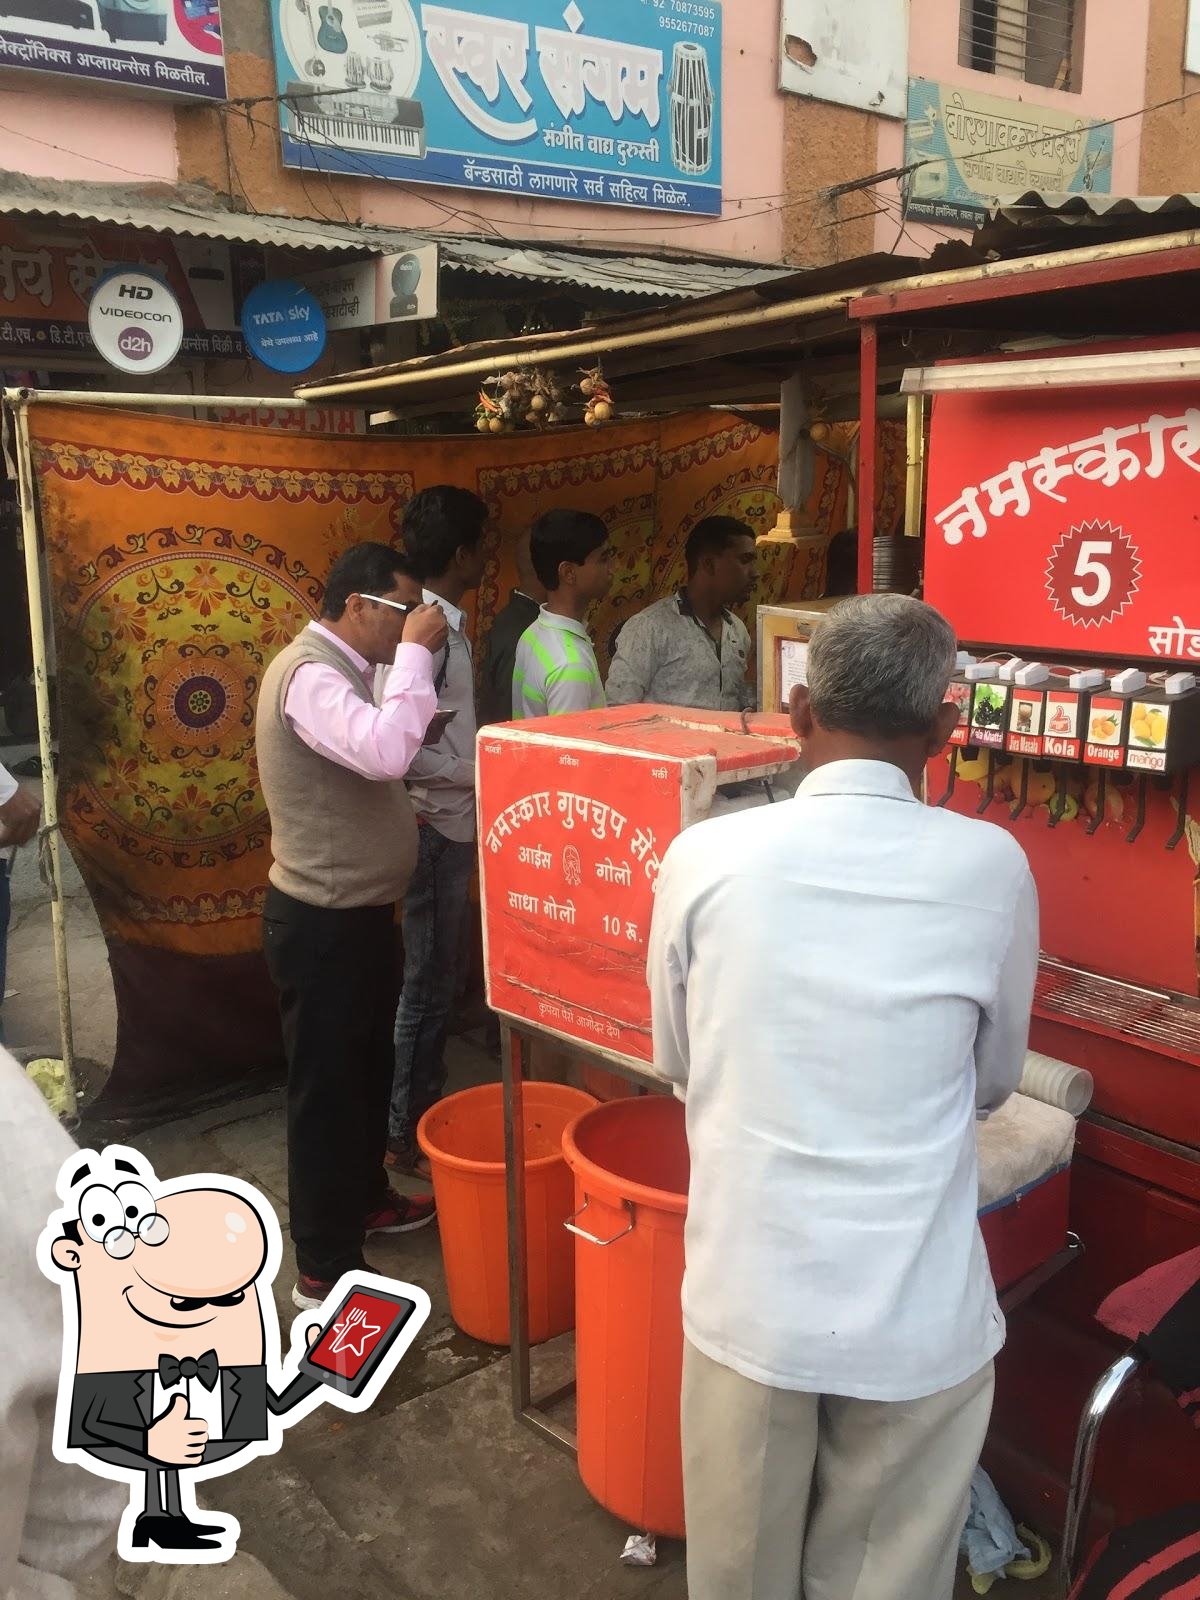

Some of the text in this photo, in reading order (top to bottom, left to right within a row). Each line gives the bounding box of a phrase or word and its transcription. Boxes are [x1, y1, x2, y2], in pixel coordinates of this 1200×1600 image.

[670, 0, 715, 20] 70873595
[658, 16, 715, 37] 9552677087
[77, 53, 151, 77] अप्लायन्सेस
[154, 61, 210, 86] मिळतील.
[543, 123, 584, 151] संगीत
[588, 133, 614, 156] वाद्य
[463, 158, 523, 188] बॅन्डसाठी
[529, 172, 578, 194] लागणारे
[584, 178, 604, 197] सर्व
[652, 185, 692, 208] मिळेल.
[118, 283, 154, 301] HD
[253, 311, 284, 325] TATA
[119, 335, 152, 353] d2h
[303, 330, 319, 342] आहे
[1071, 540, 1112, 607] 5
[1044, 735, 1076, 757] Kola
[1087, 744, 1120, 761] Orange
[1129, 752, 1164, 768] mango
[485, 791, 552, 854] नमस्कार
[556, 791, 627, 840] गुपचुप
[518, 844, 632, 887] आईस गोलो
[508, 890, 539, 914] साधा
[543, 895, 576, 924] गोलो
[603, 914, 621, 936] 10
